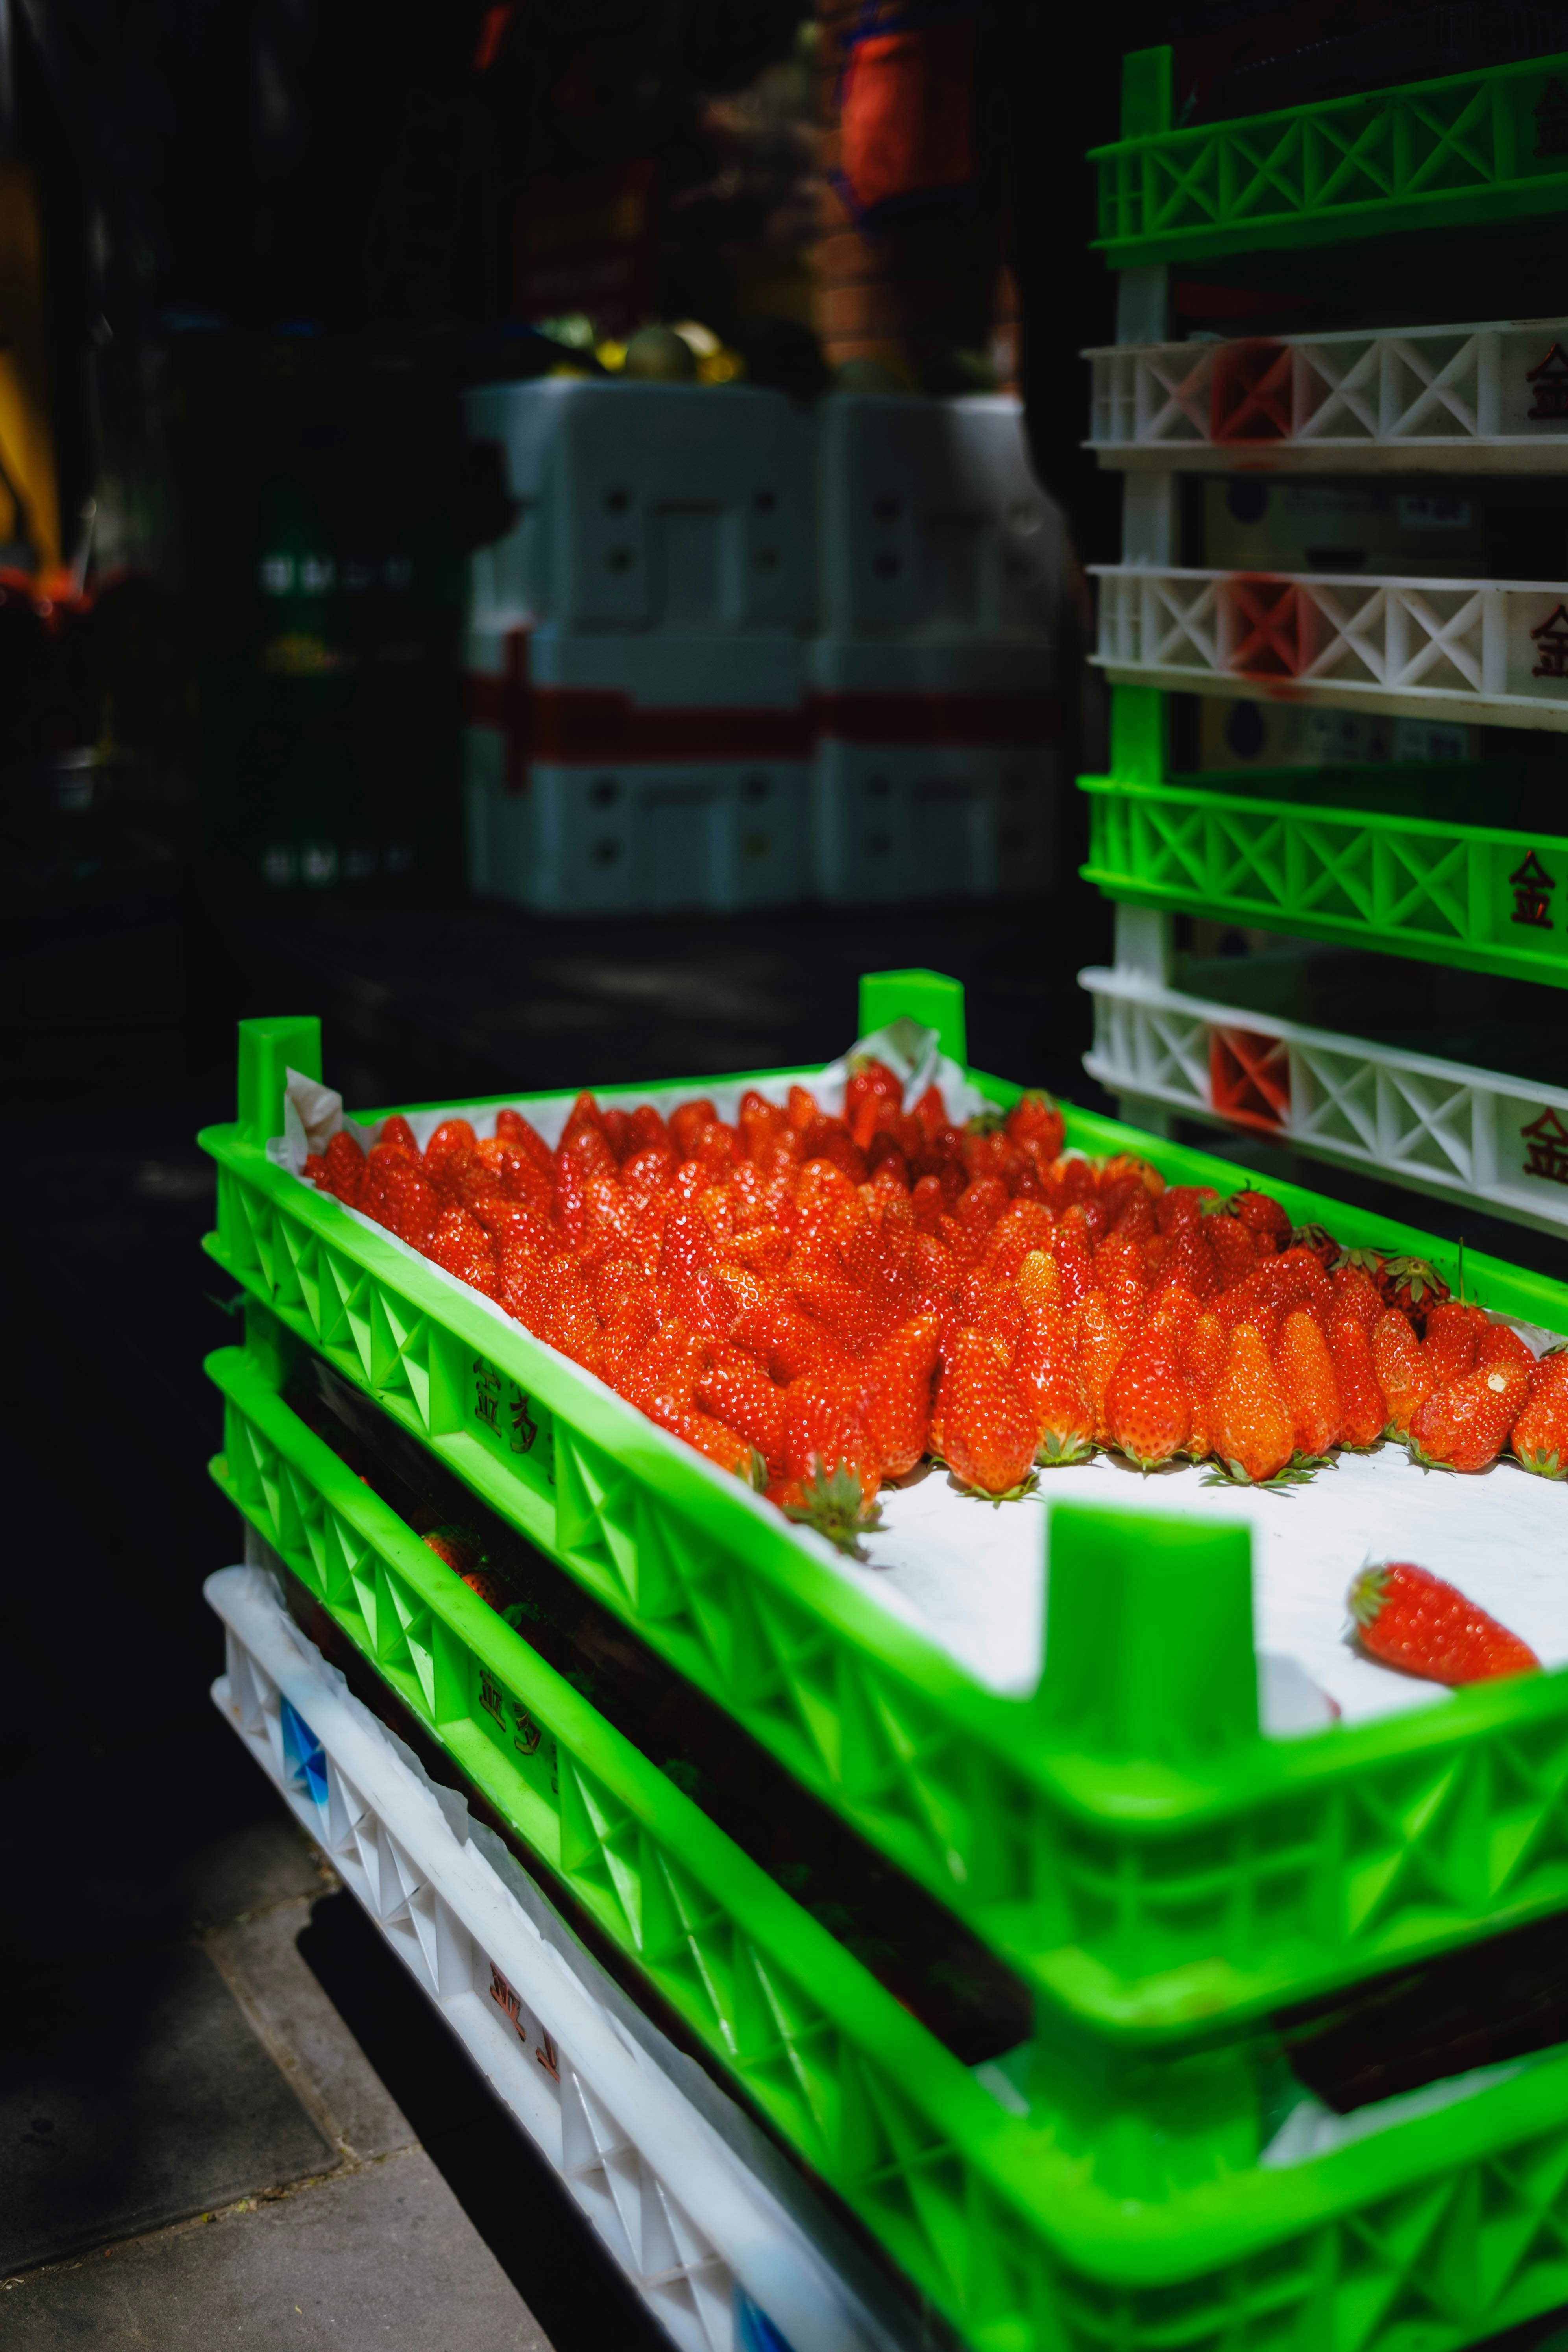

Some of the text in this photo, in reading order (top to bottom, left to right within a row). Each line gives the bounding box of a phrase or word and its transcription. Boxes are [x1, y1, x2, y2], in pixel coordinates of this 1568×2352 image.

[1525, 342, 1568, 420] 金
[1530, 604, 1568, 677] 金
[1509, 849, 1555, 930] 金
[1520, 1107, 1568, 1185] 金
